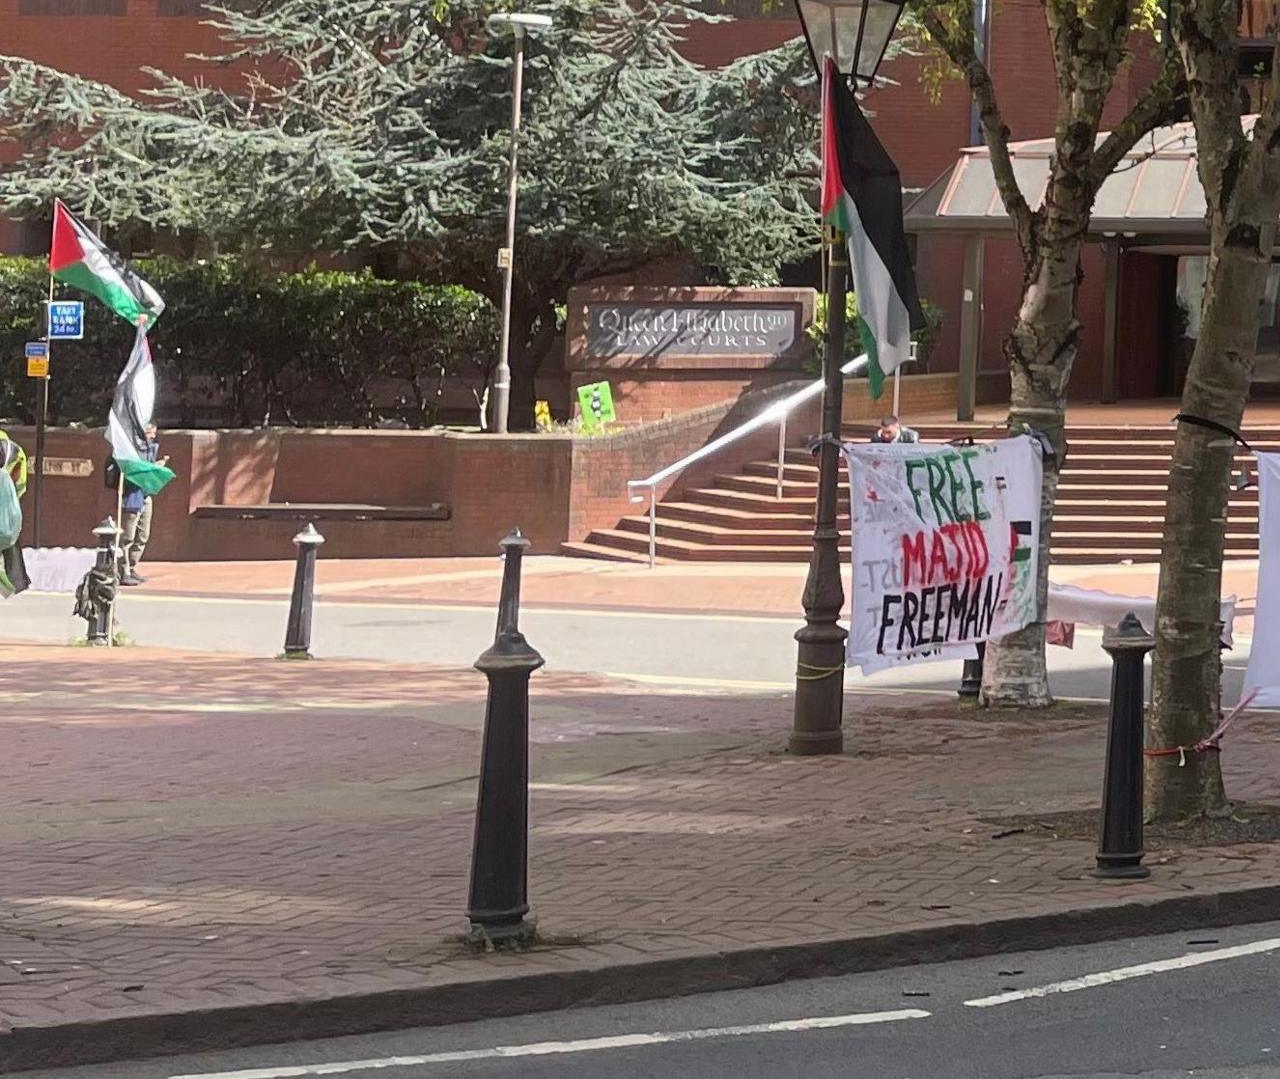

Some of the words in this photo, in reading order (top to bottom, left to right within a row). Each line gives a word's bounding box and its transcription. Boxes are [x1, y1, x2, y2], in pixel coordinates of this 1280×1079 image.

[616, 334, 660, 346] LAW
[676, 334, 768, 346] COURTS
[905, 450, 991, 526] FREE
[902, 520, 989, 587] MAJID
[877, 572, 1003, 654] FREEMAN
